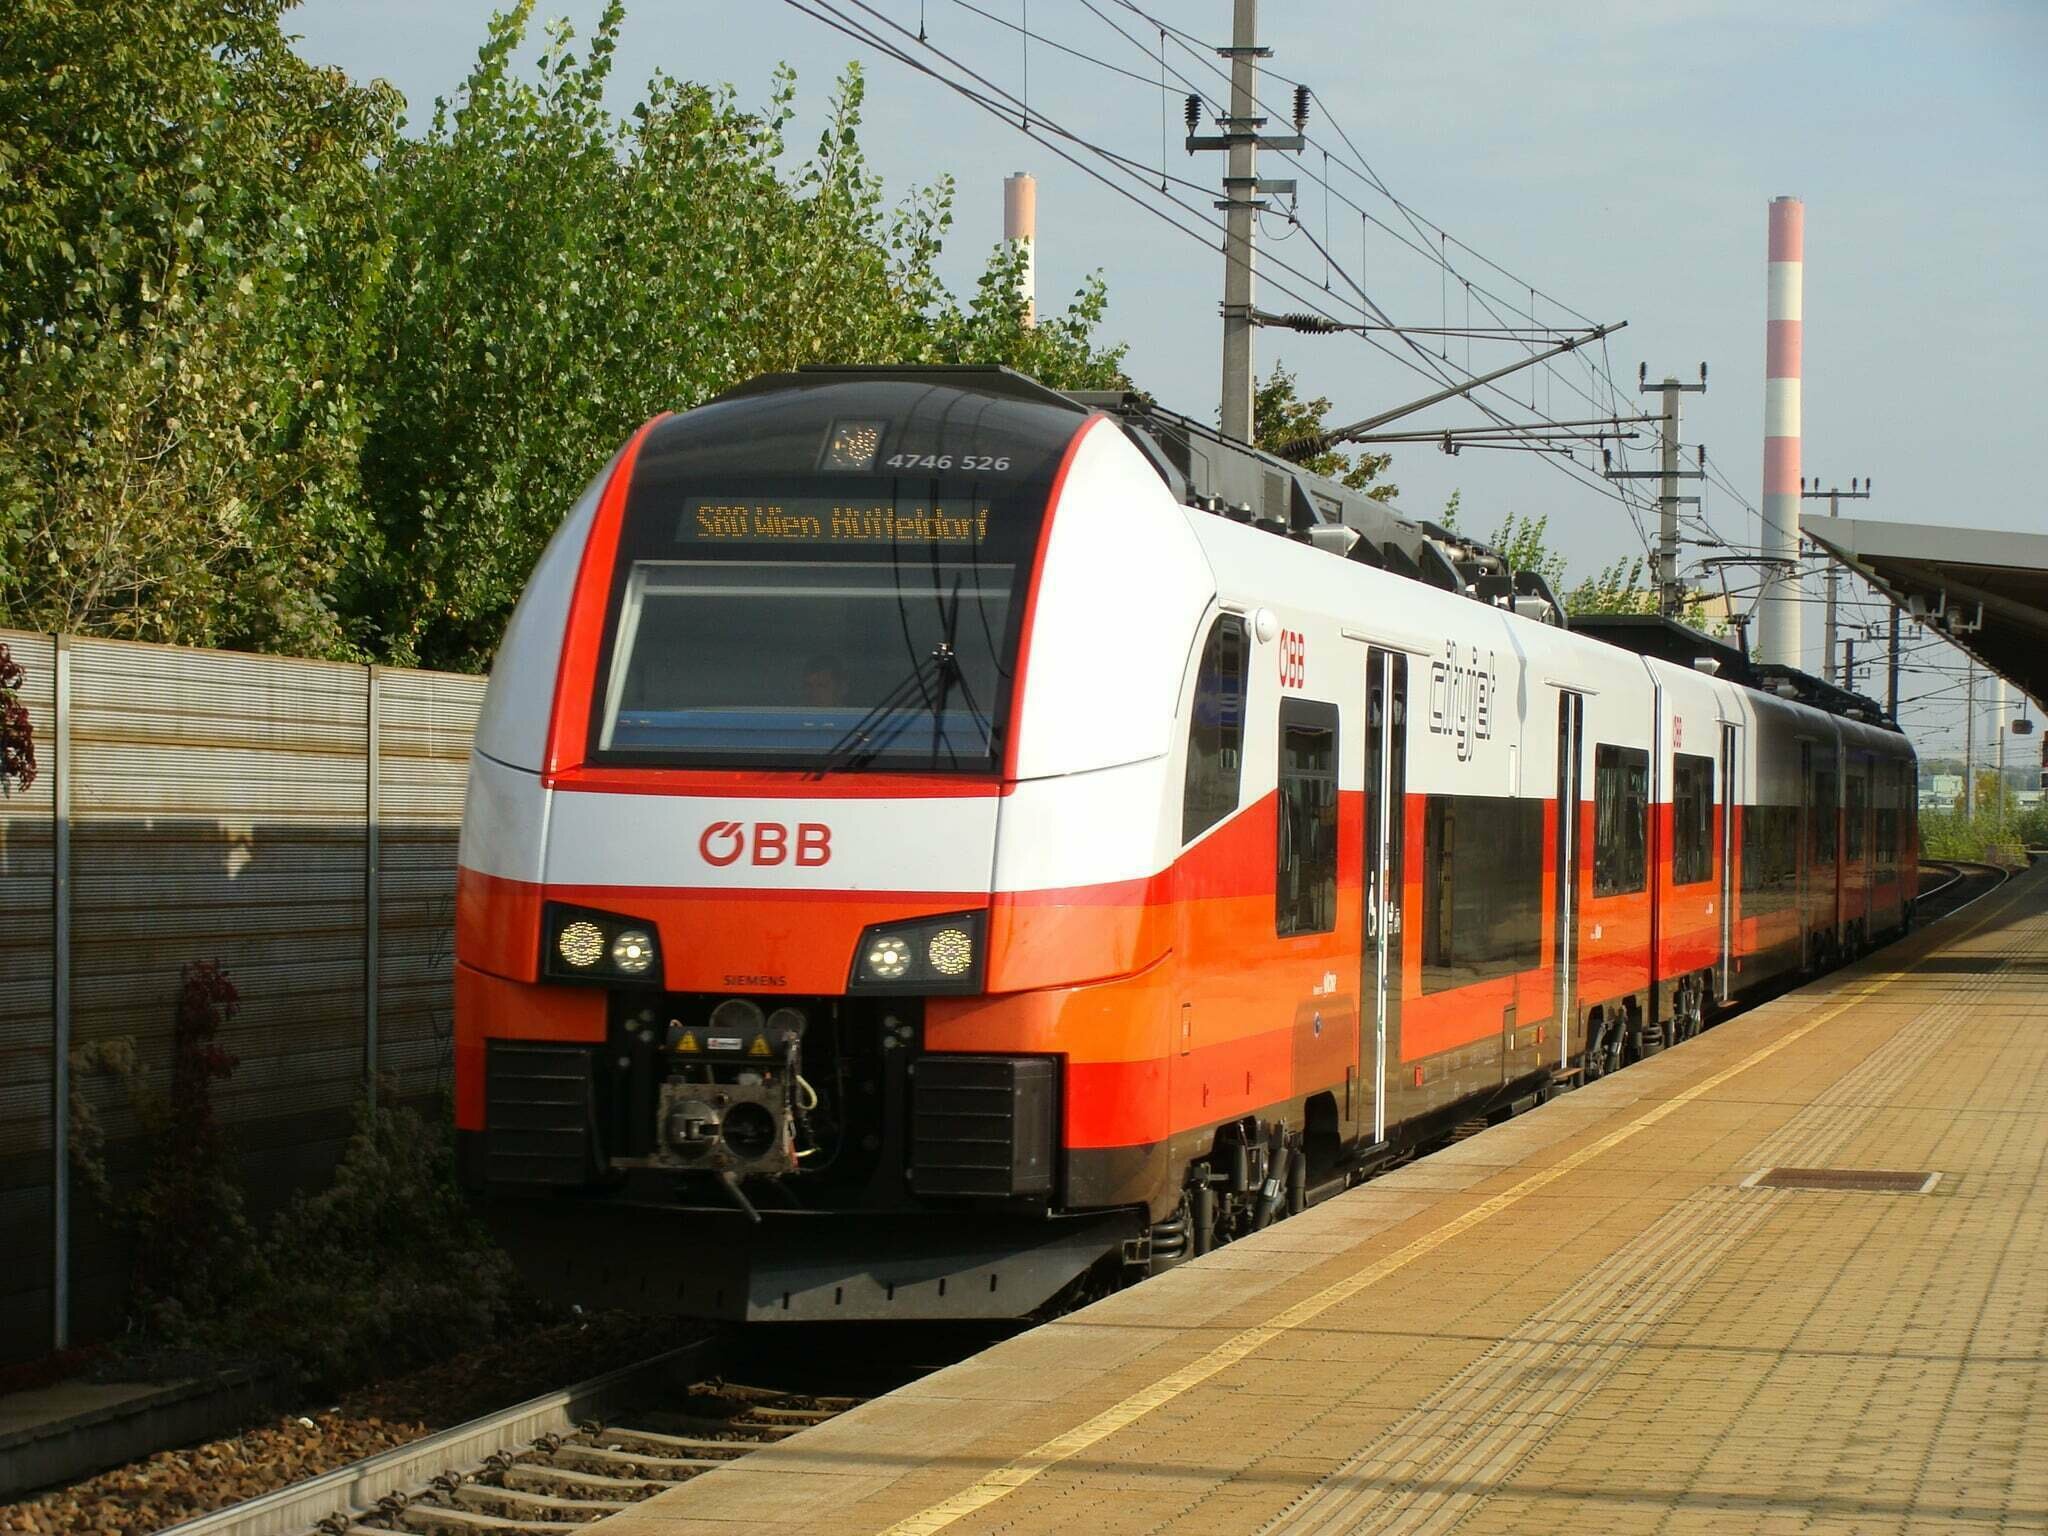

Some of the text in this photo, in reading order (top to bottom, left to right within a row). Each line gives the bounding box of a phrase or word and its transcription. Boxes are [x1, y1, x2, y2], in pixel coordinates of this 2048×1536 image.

[886, 454, 1012, 472] 4746 526
[753, 506, 821, 539] Wien
[1278, 627, 1305, 690] ÖBB
[699, 820, 833, 868] ÖBB
[723, 974, 787, 988] SIEMENS
